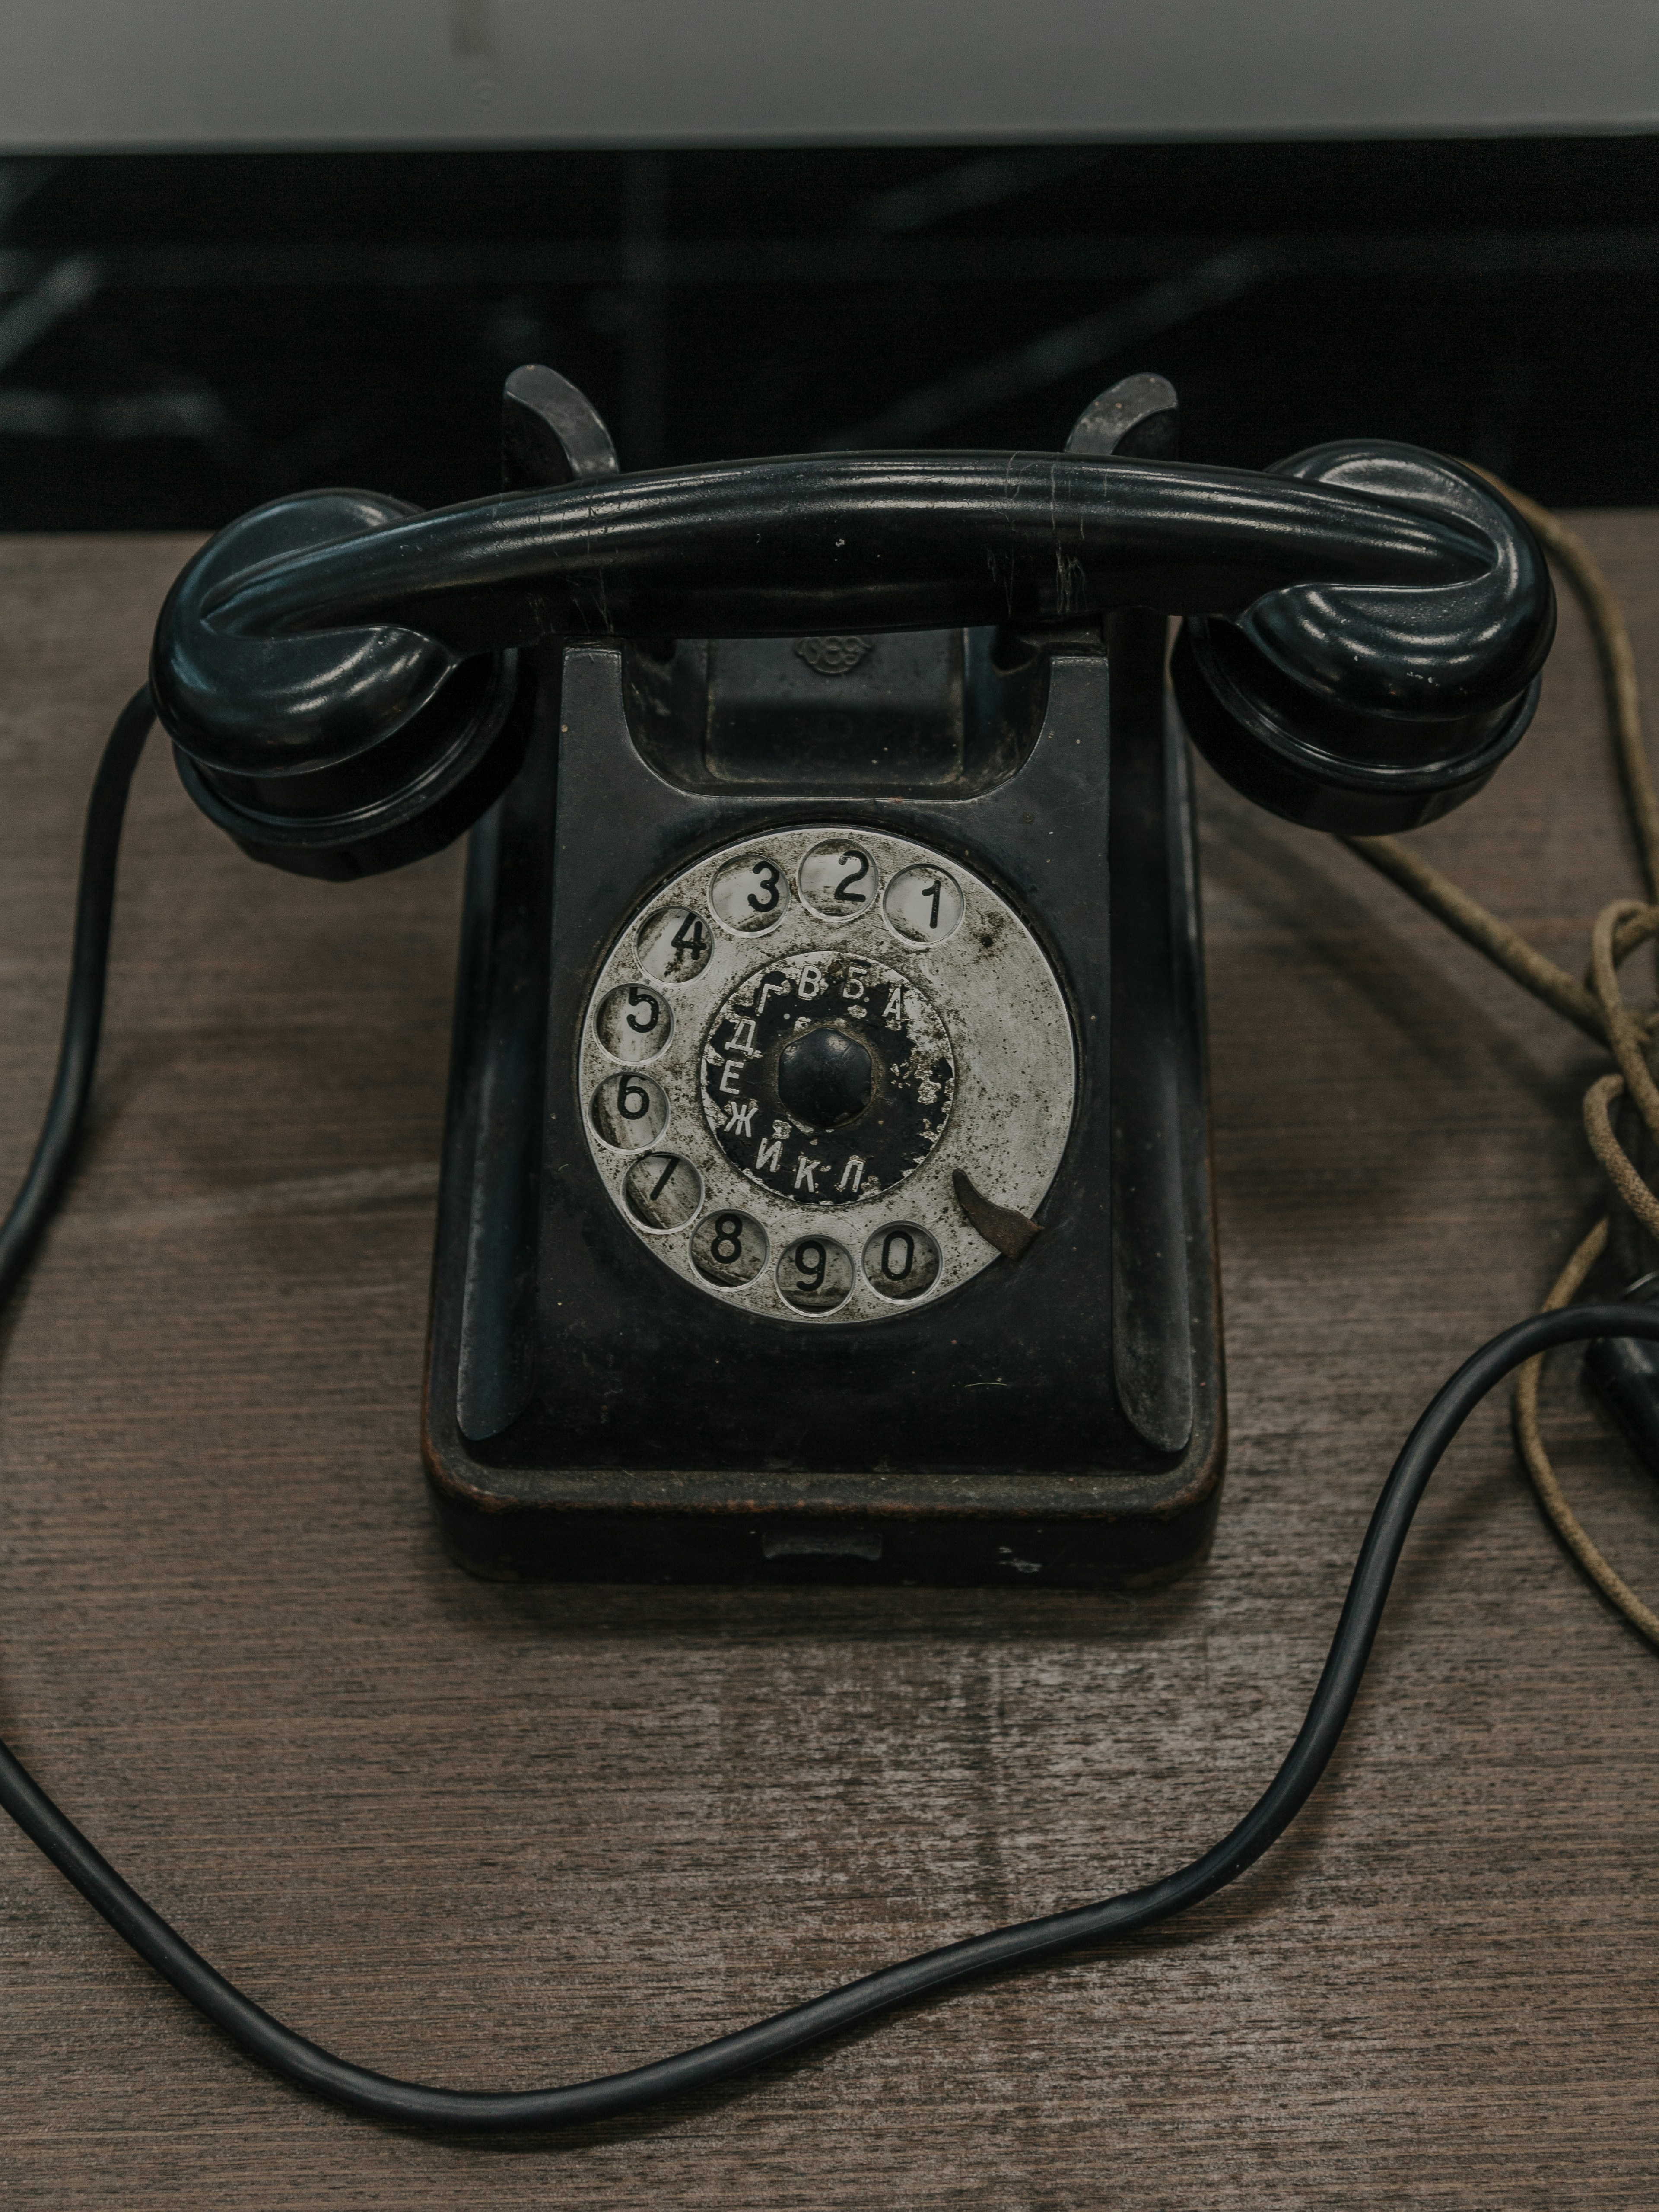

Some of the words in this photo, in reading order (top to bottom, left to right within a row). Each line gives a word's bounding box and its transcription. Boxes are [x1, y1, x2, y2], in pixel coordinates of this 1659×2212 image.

[747, 861, 779, 912] 3
[834, 850, 869, 903] 2
[921, 880, 942, 929] 1
[671, 912, 707, 960] 4
[756, 983, 783, 1016] Г
[798, 965, 822, 1000] В
[842, 966, 867, 999] Б
[882, 988, 902, 1020] А
[626, 987, 659, 1033] 5
[724, 1019, 756, 1056] Д
[618, 1074, 650, 1120] 6
[719, 1060, 744, 1095] Е
[724, 1102, 759, 1138] Ж
[650, 1155, 680, 1201] 7
[755, 1138, 782, 1172] И
[794, 1158, 820, 1193] К
[710, 1213, 742, 1264] 8
[880, 1230, 914, 1281] 0
[795, 1241, 826, 1292] 9
